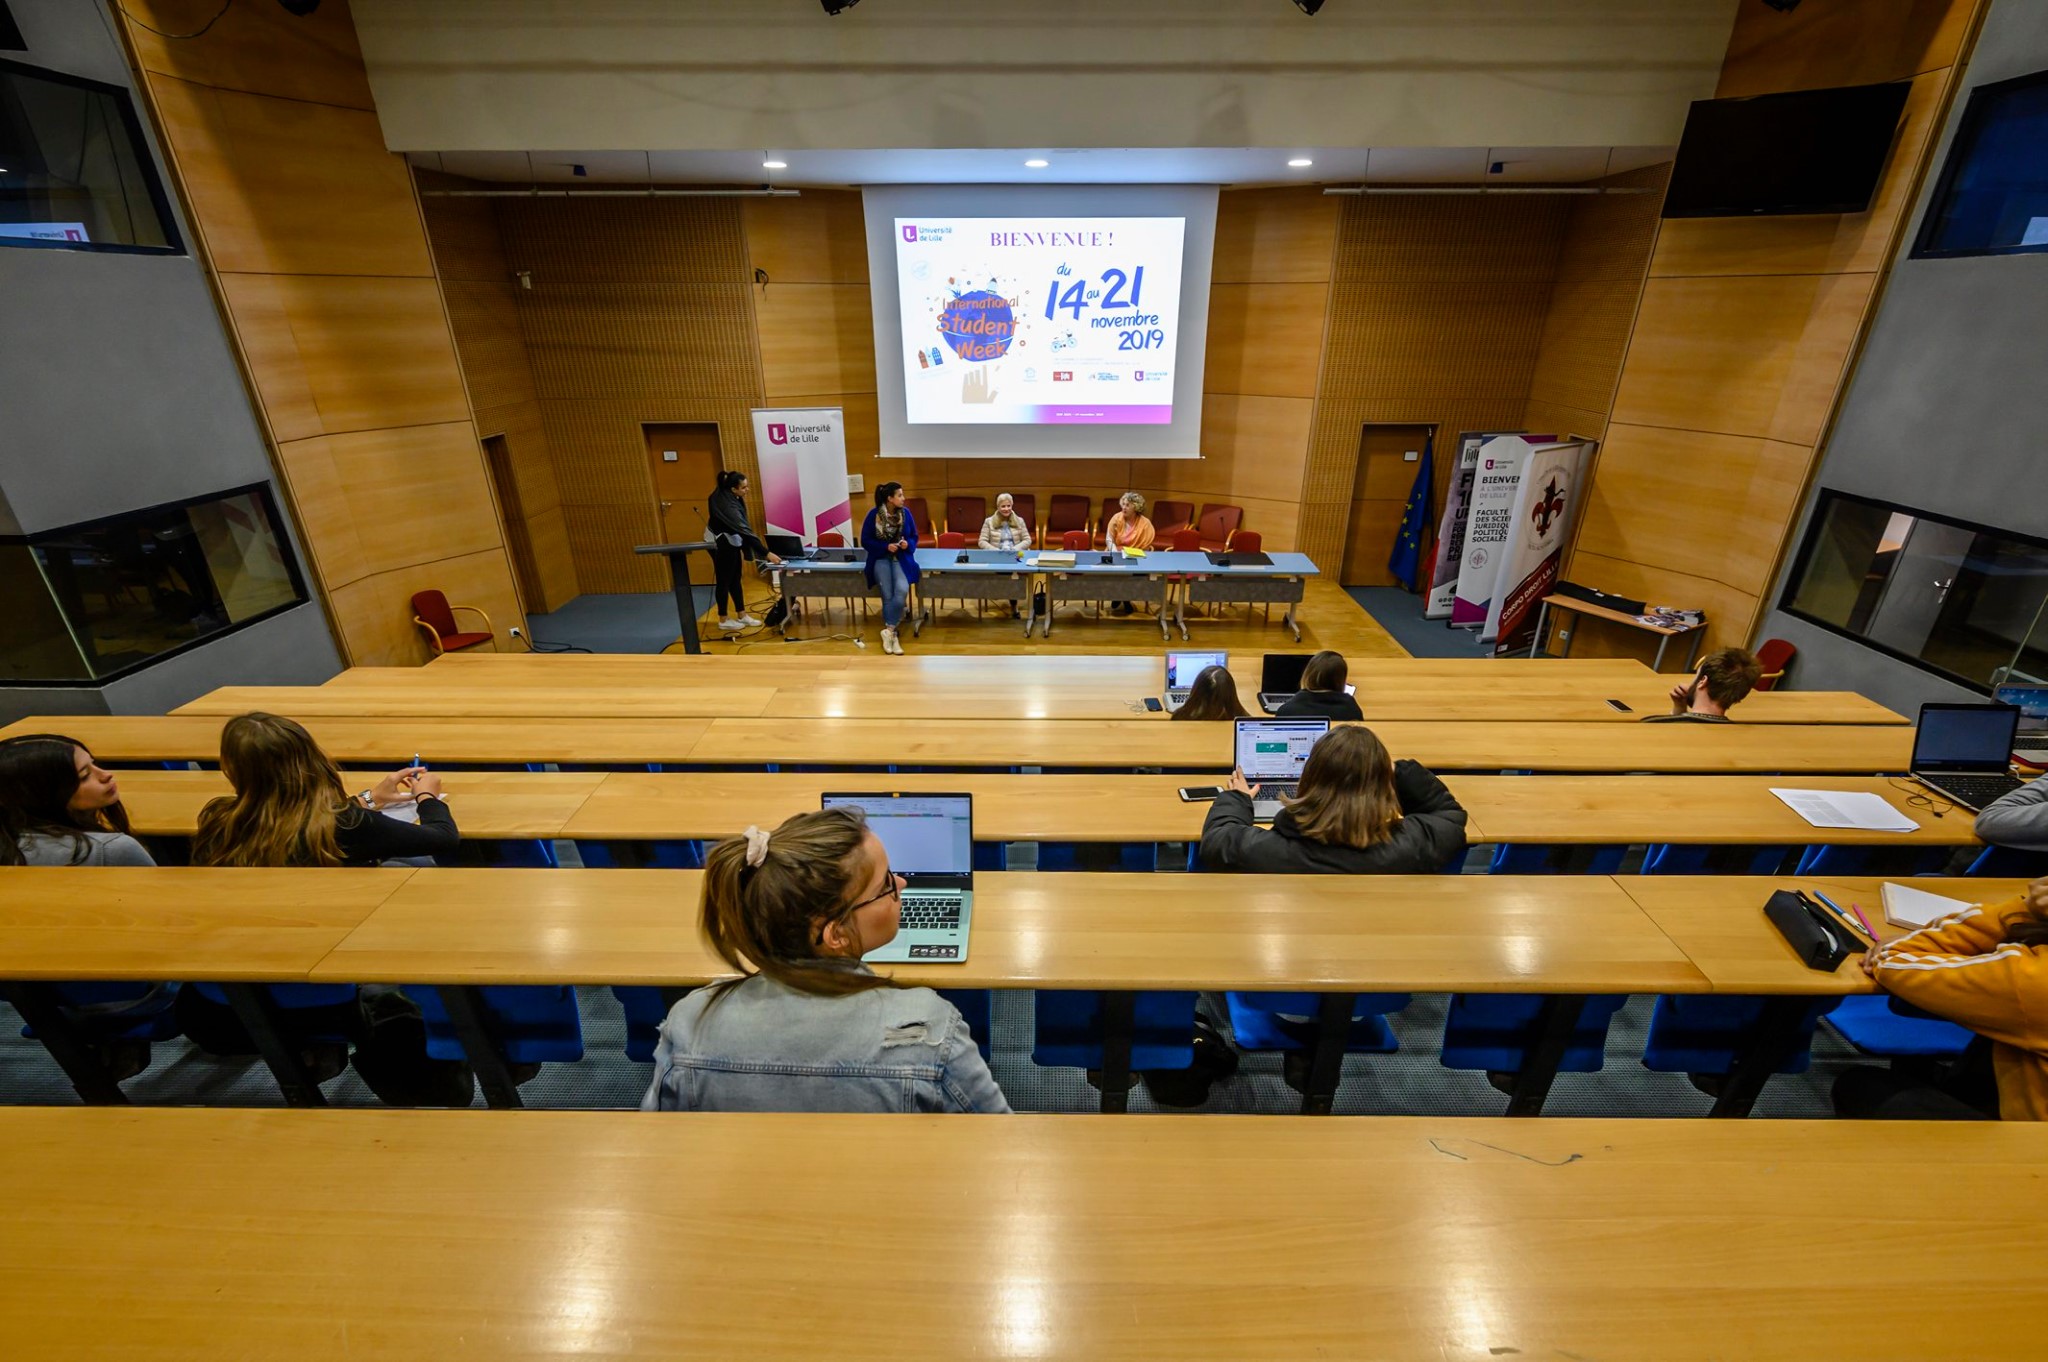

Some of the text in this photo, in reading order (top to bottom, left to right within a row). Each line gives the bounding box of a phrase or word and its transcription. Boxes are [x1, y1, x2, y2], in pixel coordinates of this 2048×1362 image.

[991, 232, 1113, 247] BIENVENUE !
[1056, 262, 1072, 276] du
[1045, 265, 1144, 321] 14 au 21
[943, 295, 1019, 310] International
[936, 313, 1020, 337] Student
[1091, 309, 1159, 328] novembre
[1118, 329, 1164, 350] 2019
[957, 338, 1008, 360] Week
[788, 424, 831, 433] Université
[790, 434, 819, 443] de Lille
[1476, 507, 1508, 516] FACULTÉ
[1502, 595, 1524, 620] CORPO
[1524, 577, 1543, 598] DROIT
